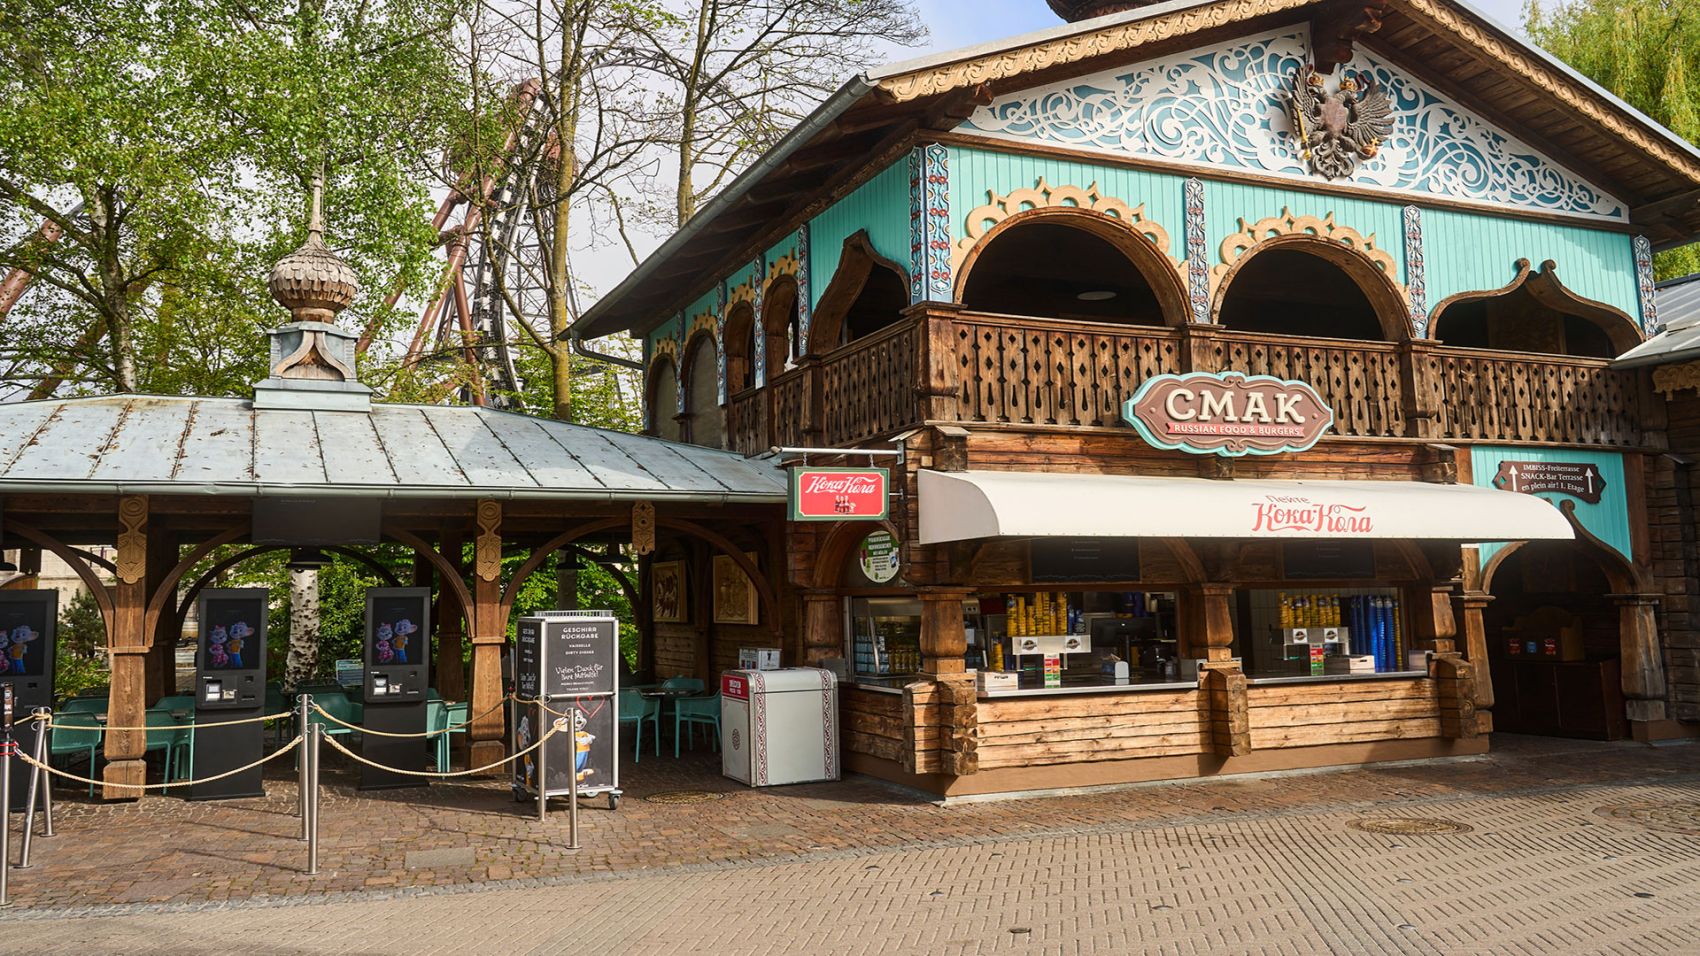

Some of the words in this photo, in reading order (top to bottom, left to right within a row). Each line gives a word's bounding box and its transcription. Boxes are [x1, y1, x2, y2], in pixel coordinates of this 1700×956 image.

[1174, 424, 1217, 433] RUSSIAN
[1219, 425, 1247, 434] FOOD
[1258, 427, 1300, 435] BURGERS
[1520, 472, 1557, 480] SNACK-Bar
[1558, 473, 1584, 481] Terrasse
[1530, 482, 1547, 491] plein
[1567, 483, 1585, 493] Etage
[561, 632, 599, 640] RÜCKGABE
